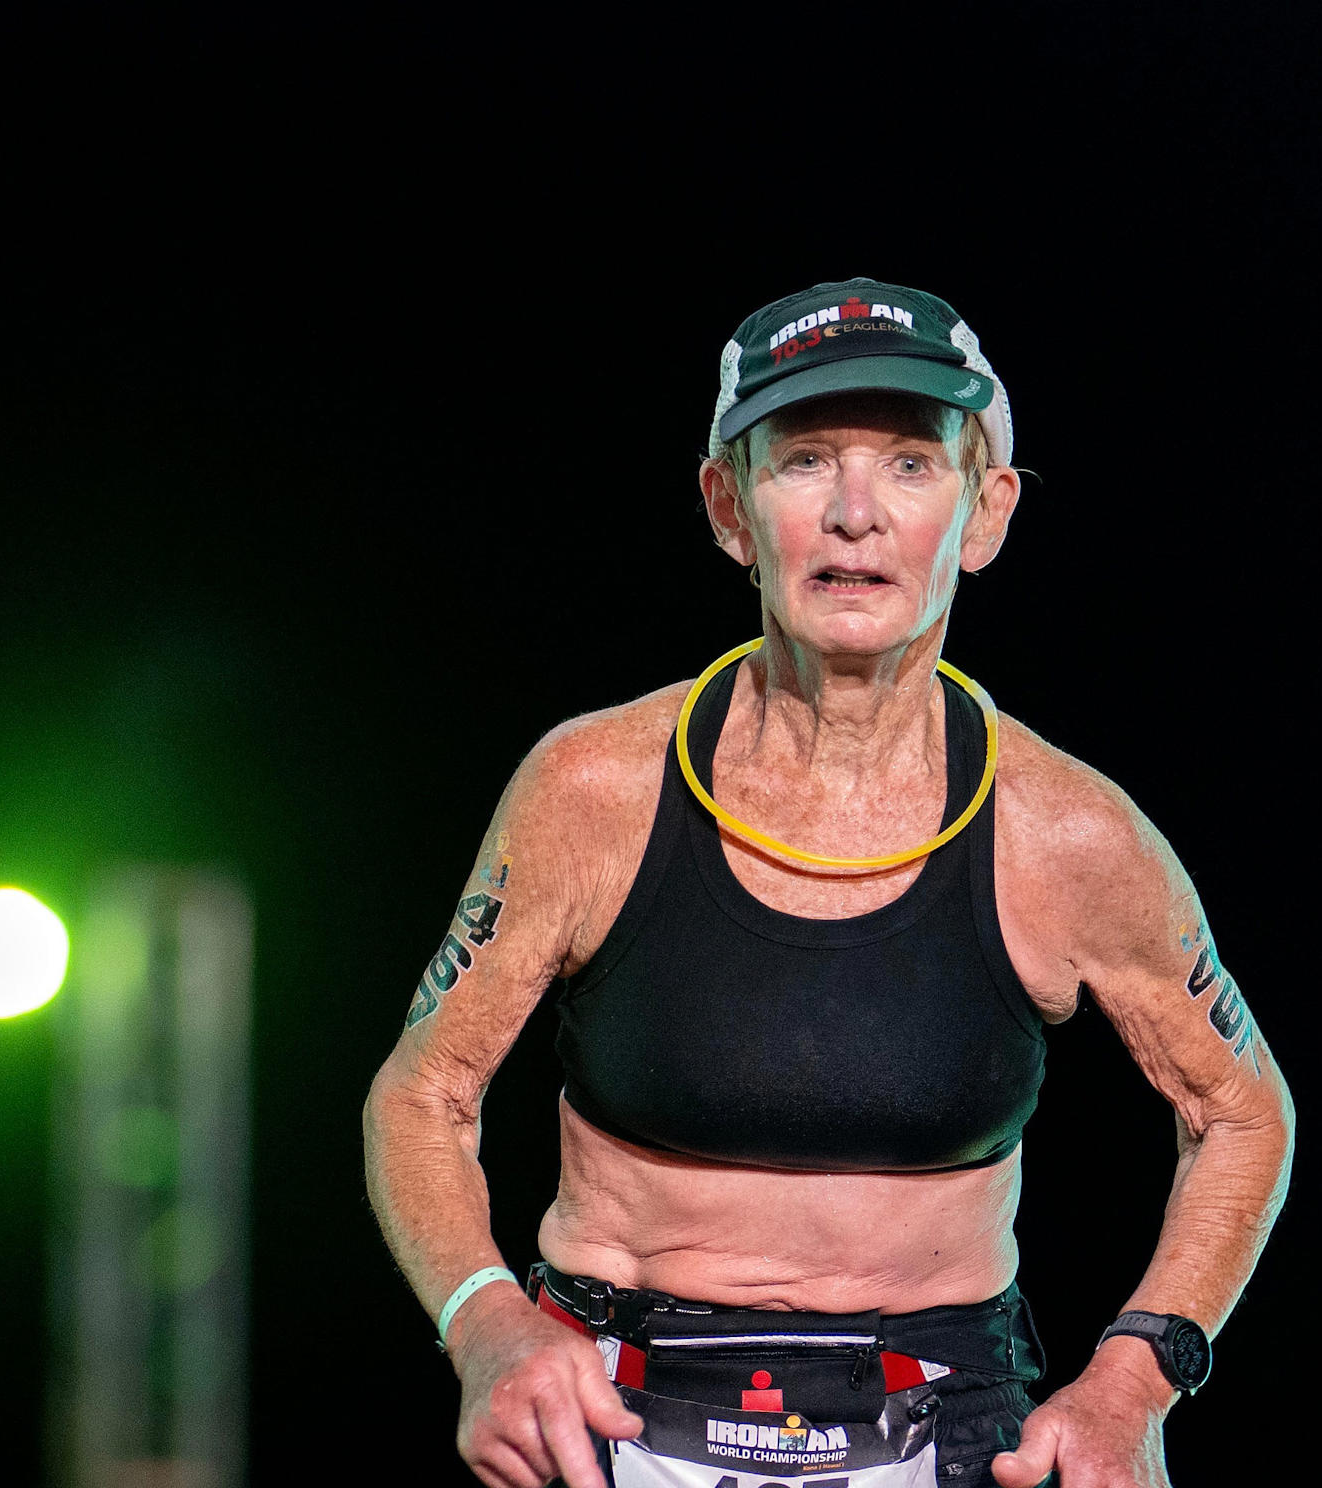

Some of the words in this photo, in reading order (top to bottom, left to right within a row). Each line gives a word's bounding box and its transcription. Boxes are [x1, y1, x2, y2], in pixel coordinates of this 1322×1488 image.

[769, 297, 914, 350] IRONMAN
[770, 328, 822, 367] 70.3
[707, 1414, 849, 1452] IRONMAN
[707, 1443, 751, 1460] WORLD
[753, 1450, 847, 1465] CHAMPIONSHIP
